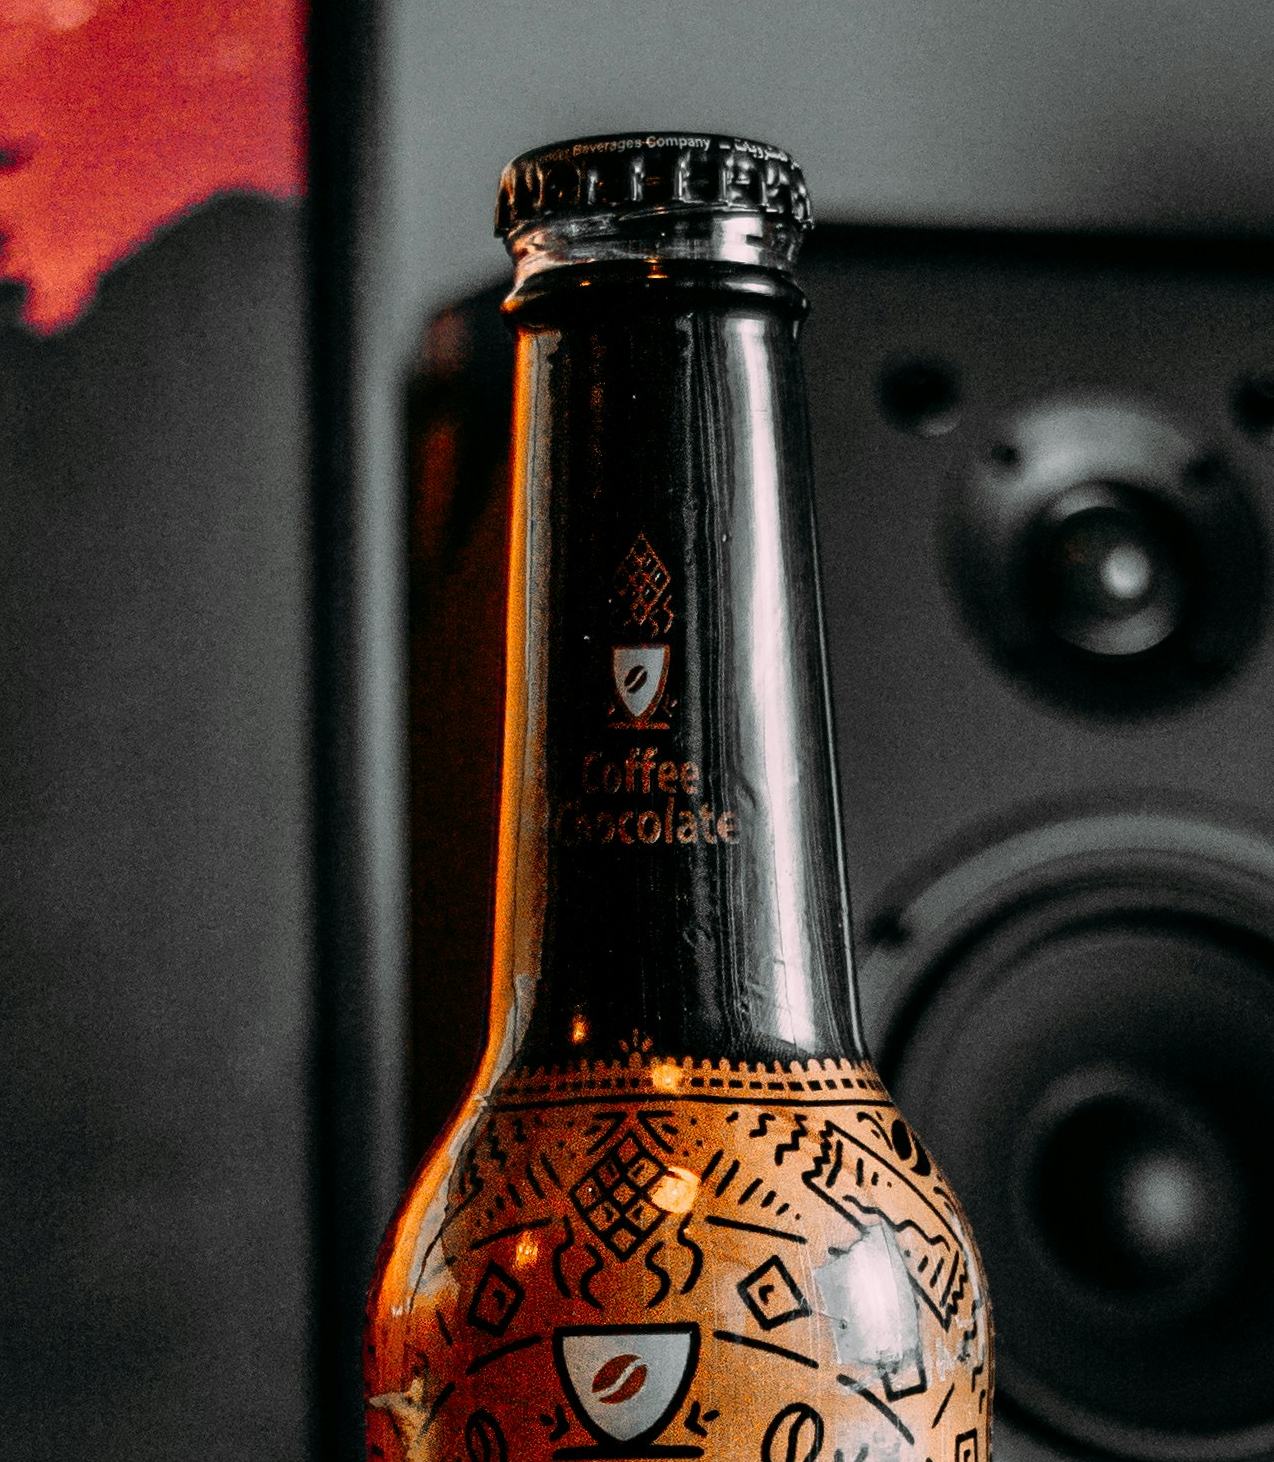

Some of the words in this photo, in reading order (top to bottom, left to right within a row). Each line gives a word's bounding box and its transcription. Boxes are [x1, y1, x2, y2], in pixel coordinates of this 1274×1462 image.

[572, 138, 643, 157] Beverages
[645, 135, 711, 151] Company
[581, 745, 701, 795] Coffee
